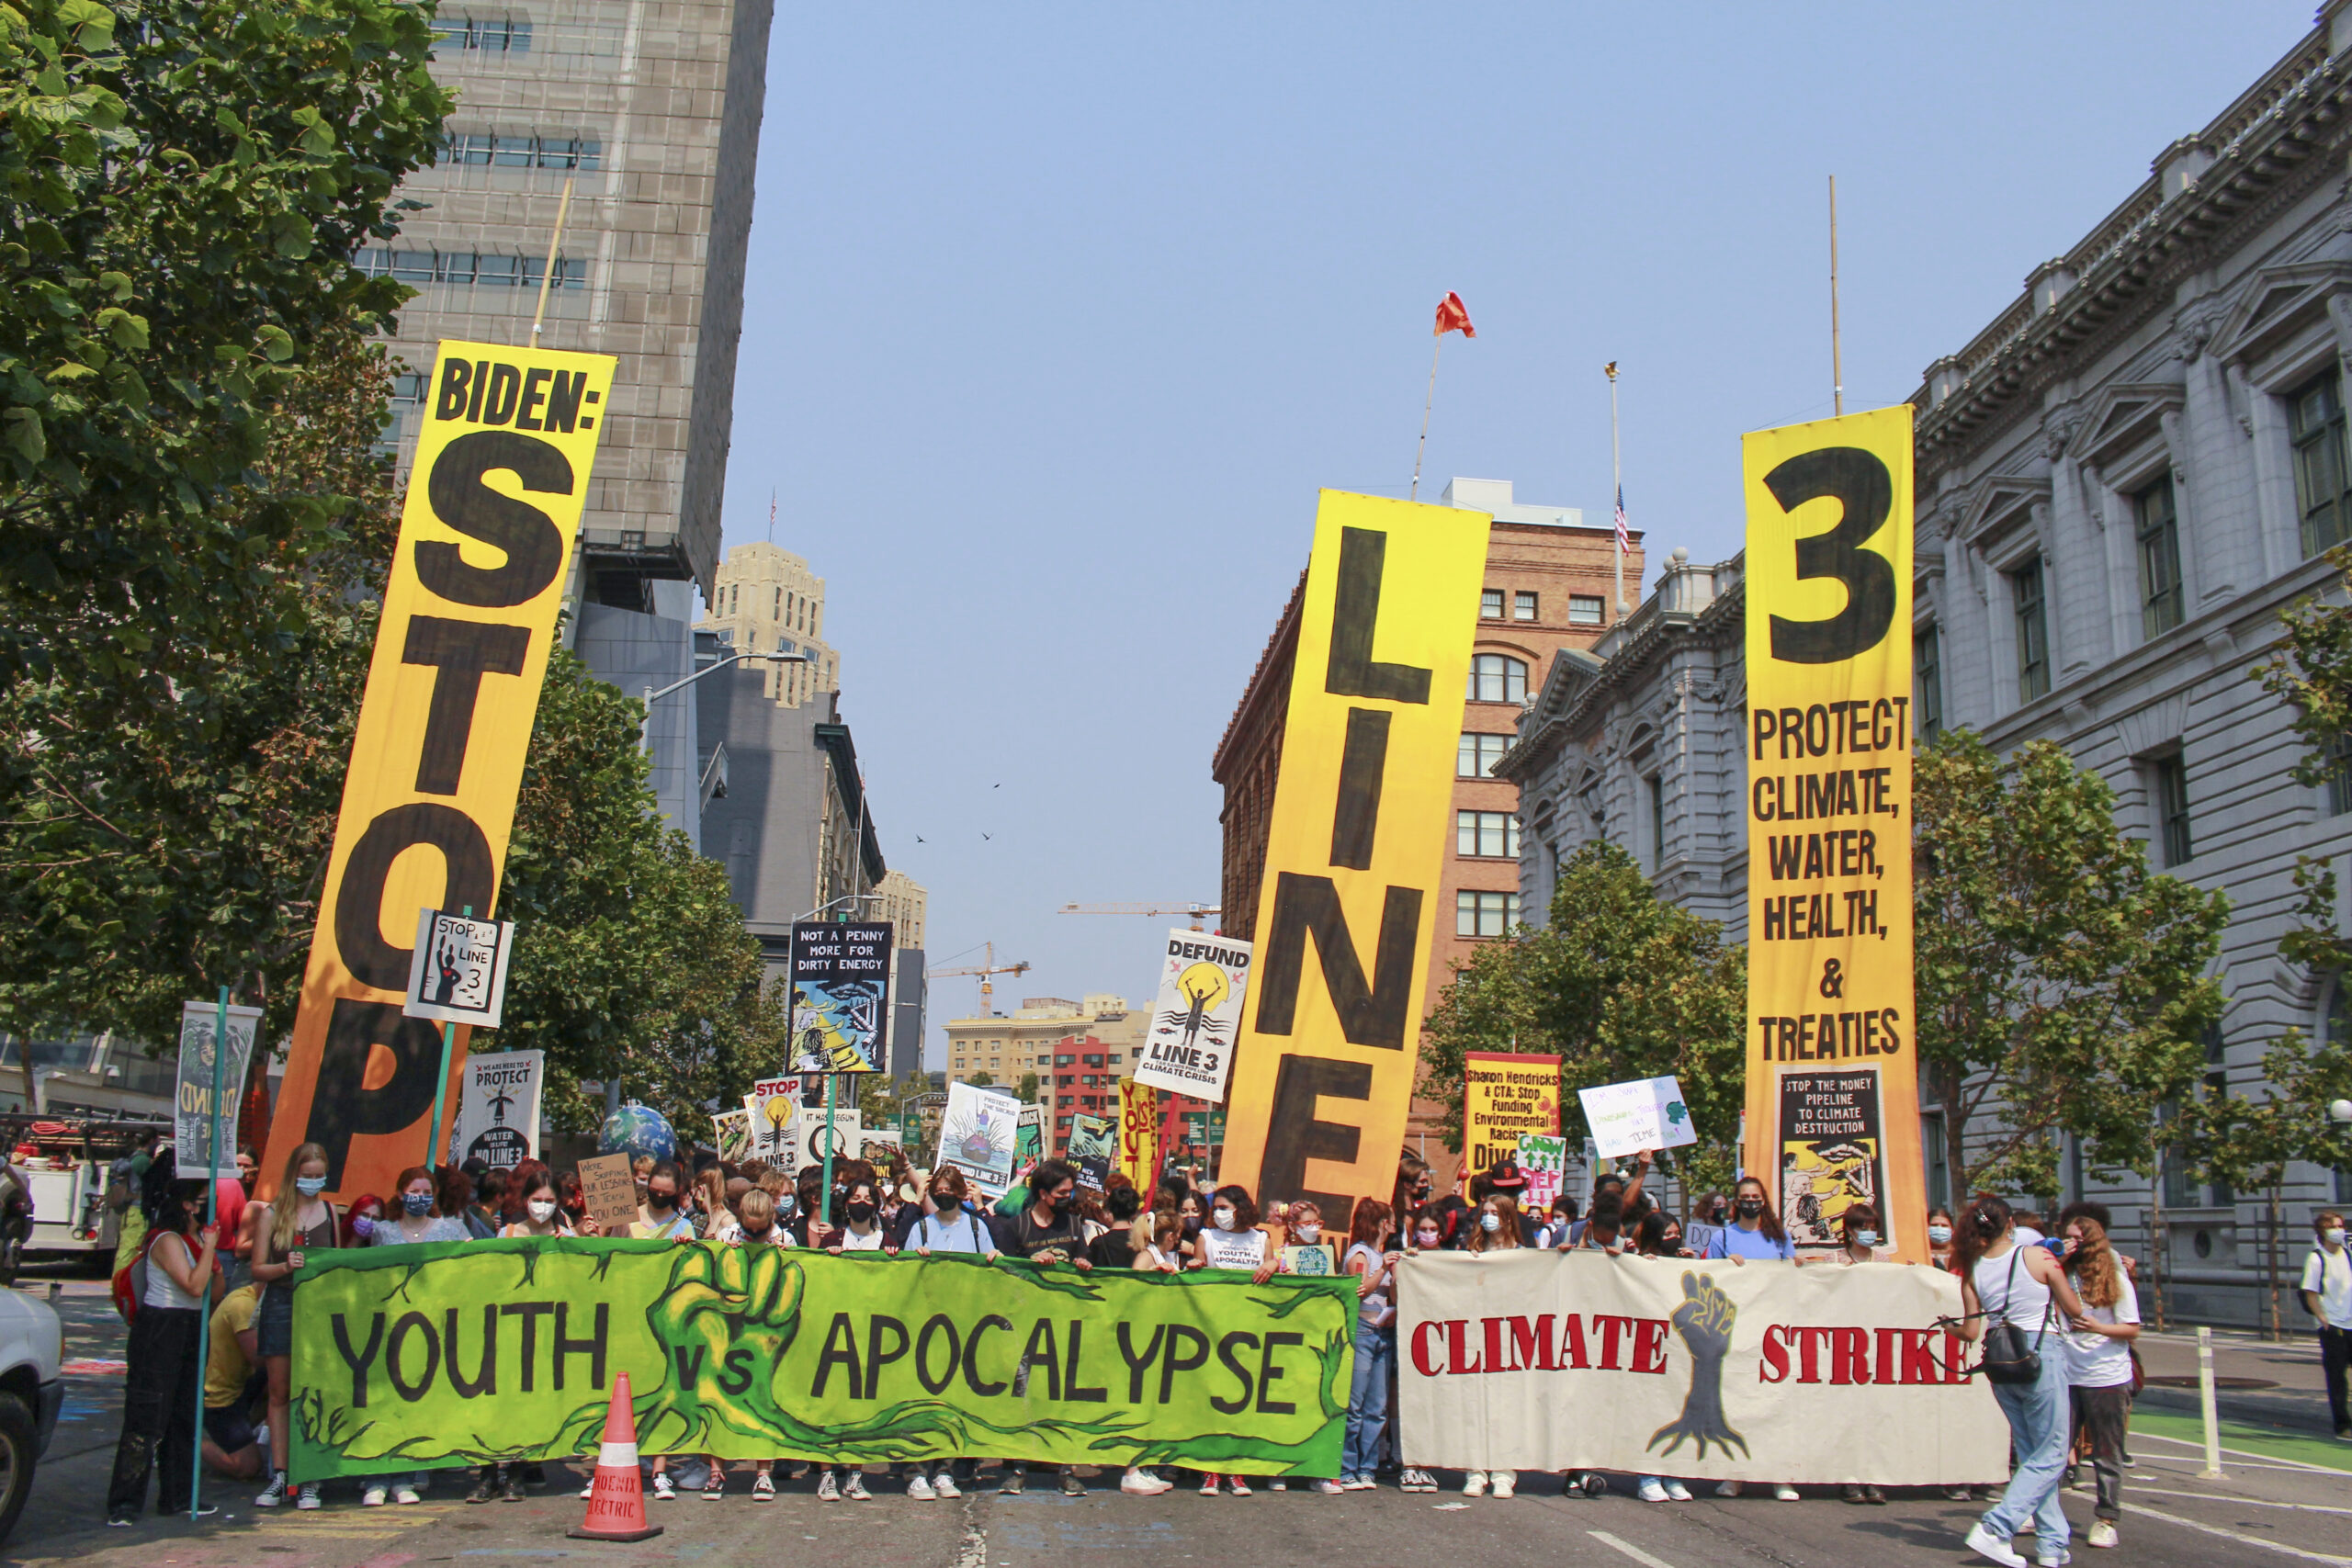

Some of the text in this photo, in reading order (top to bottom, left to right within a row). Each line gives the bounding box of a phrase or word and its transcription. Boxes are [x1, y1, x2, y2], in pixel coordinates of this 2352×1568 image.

[435, 356, 602, 434] BIDEN:
[1763, 446, 1897, 665] 3
[1754, 695, 1909, 761] PROTECT
[1753, 766, 1899, 822] CLIMATE,
[306, 431, 575, 1194] STOP
[1769, 829, 1884, 882] WATER,
[1255, 526, 1433, 1232] LINE
[1763, 888, 1888, 942] HEALTH,
[438, 919, 476, 938] STOP
[800, 931, 884, 942] NOT A PENNY
[458, 947, 488, 964] LINE
[809, 945, 874, 956] MORE FOR
[1168, 940, 1250, 968] DEFUND
[798, 959, 883, 971] DIRTY ENERGY
[467, 968, 481, 988] 3
[1819, 956, 1843, 999] &
[1758, 1007, 1900, 1062] TREATIES
[502, 1062, 515, 1070] HERE
[1150, 1043, 1219, 1072] LINE 3
[476, 1068, 531, 1087] PROTECT
[1143, 1062, 1217, 1084] CLIMATE CRISIS
[1468, 1070, 1558, 1087] Sharon Hendricks
[756, 1079, 799, 1097] STOP
[1485, 1086, 1541, 1100] & CTA: Stop
[1786, 1077, 1872, 1092] STOP THE MONEY
[984, 1097, 1010, 1108] PROTECT
[1492, 1100, 1532, 1114] Funding
[1805, 1093, 1854, 1106] PIPELINE
[807, 1112, 813, 1121] IT
[1475, 1112, 1549, 1127] Environmental
[1798, 1107, 1861, 1120] TO CLIMATE
[484, 1131, 514, 1142] WATER
[1628, 1127, 1657, 1144] TIME
[1794, 1121, 1865, 1134] DESTRUCTION
[1519, 1135, 1566, 1156] GROW
[491, 1147, 514, 1165] LINE
[514, 1146, 523, 1164] 3
[762, 1151, 796, 1167] INE 3
[976, 1168, 991, 1182] LINE
[587, 1194, 597, 1205] TO
[590, 1204, 634, 1222] YOU ONE
[1410, 1313, 1973, 1386] CLIMATE STRIKE
[331, 1303, 609, 1409] YOUTH
[809, 1311, 1304, 1416] APOCALYPSE
